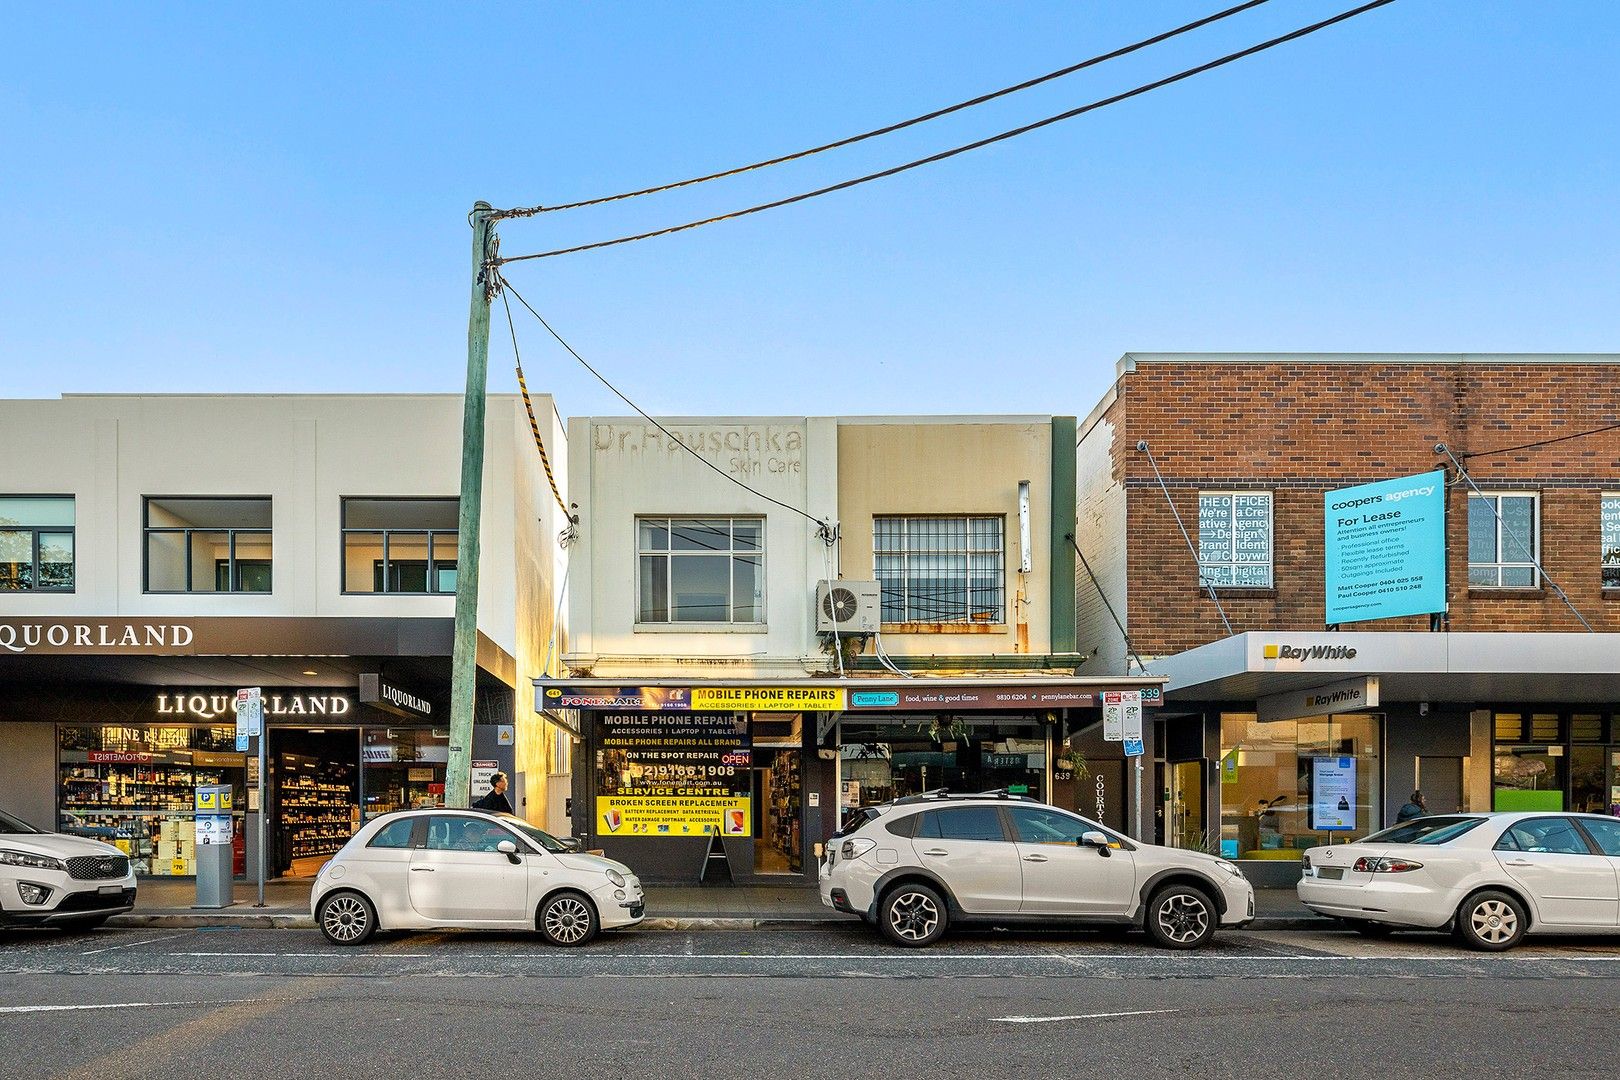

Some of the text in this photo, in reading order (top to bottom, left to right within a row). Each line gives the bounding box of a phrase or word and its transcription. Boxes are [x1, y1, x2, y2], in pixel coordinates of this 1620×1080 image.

[730, 457, 800, 473] Skin Care
[1199, 496, 1220, 507] THE
[1331, 485, 1435, 510] coopers agency
[1236, 509, 1244, 517] a
[1199, 518, 1227, 529] ative
[1337, 510, 1401, 528] For Lease
[1337, 525, 1367, 536] Attention
[1377, 517, 1425, 529] entrepreneurs
[1217, 529, 1258, 541] Design
[1337, 534, 1350, 542] and
[1350, 530, 1379, 540] business
[1341, 539, 1380, 550] Professional
[1341, 548, 1365, 558] Flexible
[1385, 543, 1405, 551] terms
[1341, 550, 1410, 566] Recently Refurbished
[1364, 558, 1404, 569] approximate
[1230, 565, 1268, 578] Digital
[1340, 570, 1374, 580] Outgoings
[1337, 584, 1353, 592] Matt
[1354, 582, 1378, 591] Cooper
[1353, 589, 1376, 598] Cooper
[0, 625, 194, 652] QUORLAND
[1279, 645, 1357, 662] RayWhite
[382, 683, 431, 715] LIQUORLAND
[698, 690, 836, 700] MOBILE PHONE REPAIRS
[905, 693, 979, 703] food, wine & good times
[1041, 693, 1092, 702] pennylanebar.com
[1140, 688, 1160, 699] 639
[1314, 688, 1361, 706] RayWhite
[857, 695, 877, 704] Penny
[158, 695, 349, 719] LIQURLAND
[604, 715, 649, 725] MOBILE
[651, 715, 692, 725] PHONE
[604, 738, 741, 746] MOBILE PHONE REPAIRS ALL BRAND
[721, 755, 750, 764] OPEN
[697, 765, 735, 776] 1908
[1054, 772, 1071, 780] 639
[617, 788, 674, 796] SERVICE
[677, 788, 730, 796] CENTRE
[609, 799, 739, 807] BROKEN SCREEN REPLACEMENT
